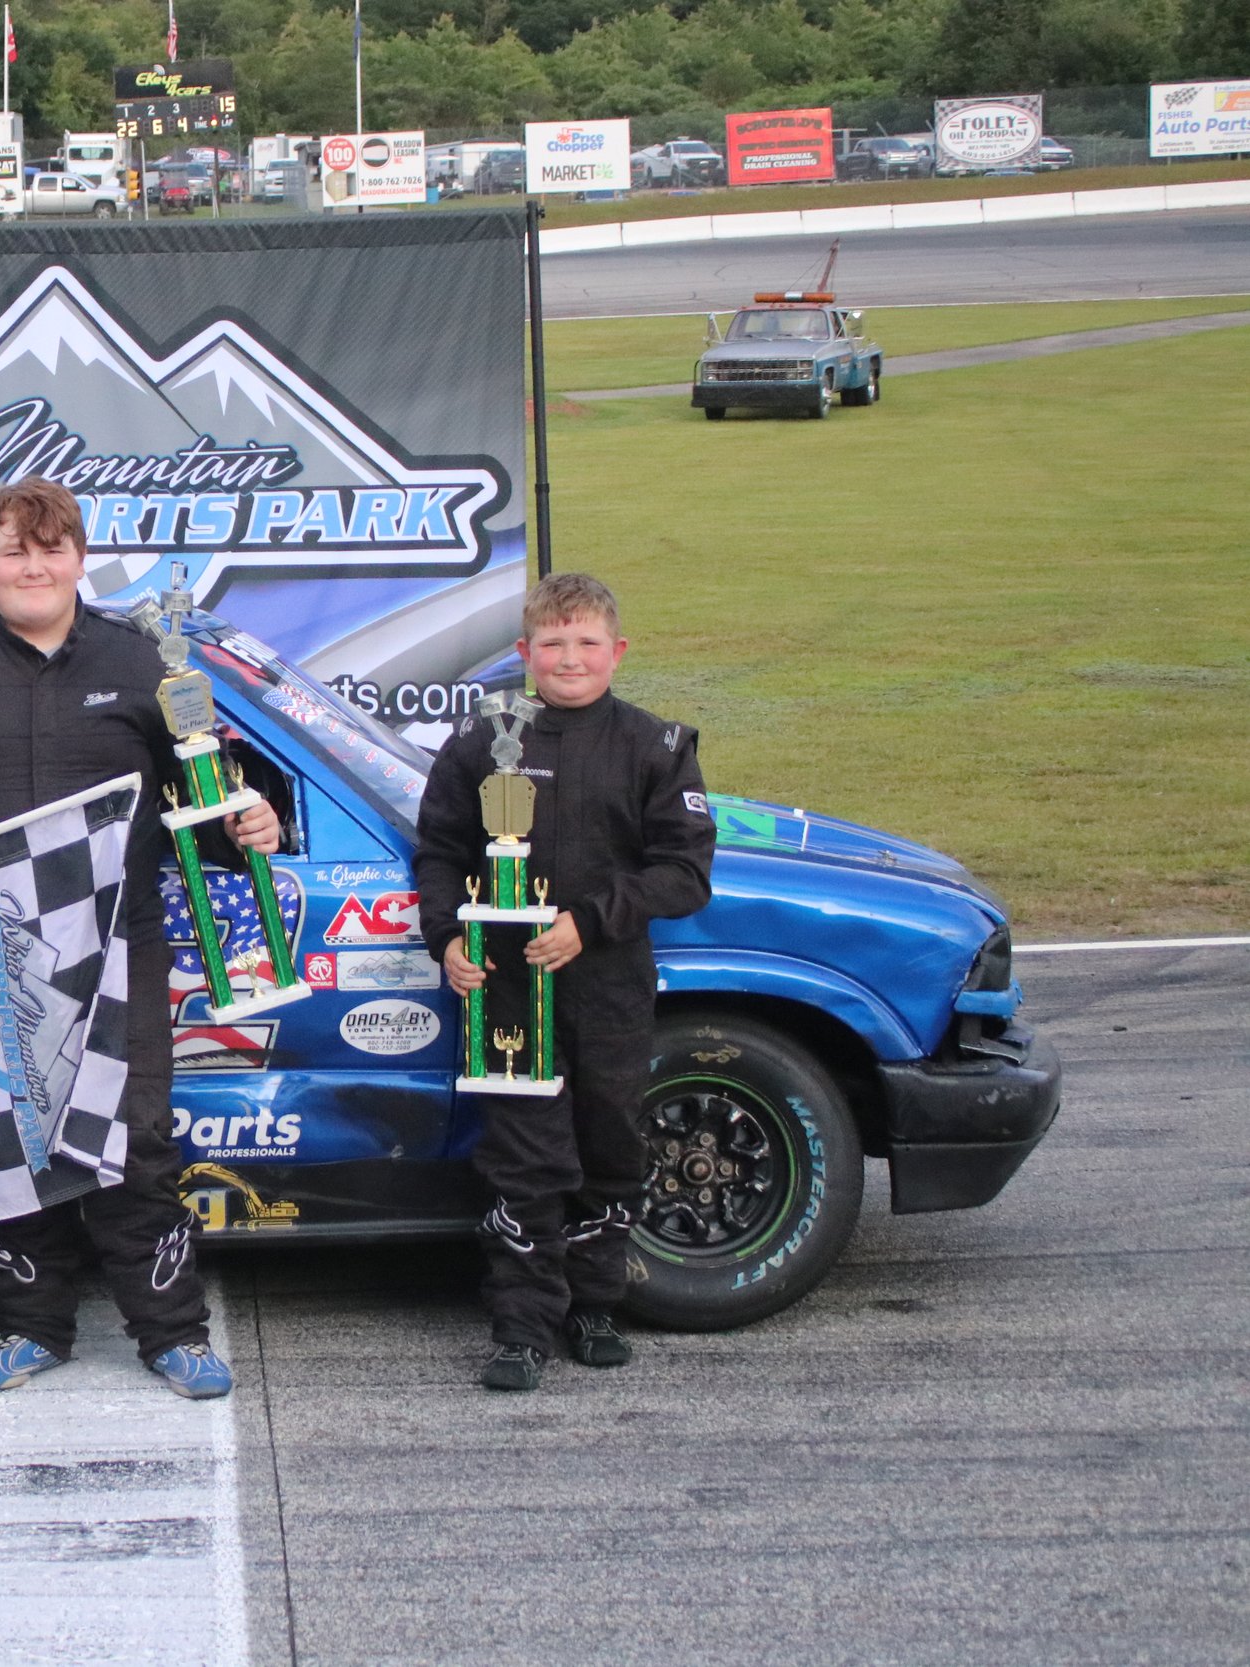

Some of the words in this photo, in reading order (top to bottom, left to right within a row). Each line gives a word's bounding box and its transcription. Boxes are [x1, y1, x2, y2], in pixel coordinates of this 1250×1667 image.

[147, 105, 155, 116] 2
[172, 103, 180, 114] 3
[219, 96, 235, 112] 15
[1158, 110, 1192, 119] FISHER
[117, 121, 138, 138] 22
[152, 119, 163, 135] 6
[177, 117, 187, 133] 4
[961, 116, 1017, 131] FOLEY
[1155, 120, 1201, 135] Auto
[571, 132, 604, 143] Price
[979, 128, 1028, 139] PROPANE
[393, 139, 422, 148] MEADOW
[547, 140, 604, 152] Chopper
[393, 148, 420, 157] LEASING
[746, 152, 813, 162] PROFESSIONAL
[743, 161, 771, 170] DRAIN
[773, 159, 817, 168] CLEANING
[542, 164, 596, 182] MARKET
[248, 485, 472, 545] PARK
[518, 766, 553, 776] arbonneau
[314, 870, 328, 881] The
[329, 864, 382, 889] Graphic
[383, 868, 405, 883] Shop
[8, 986, 52, 1115] Mountain
[13, 1101, 52, 1176] PARK
[207, 1146, 297, 1158] PROFESSIONALS
[731, 1096, 827, 1290] MASTERCRAFT
